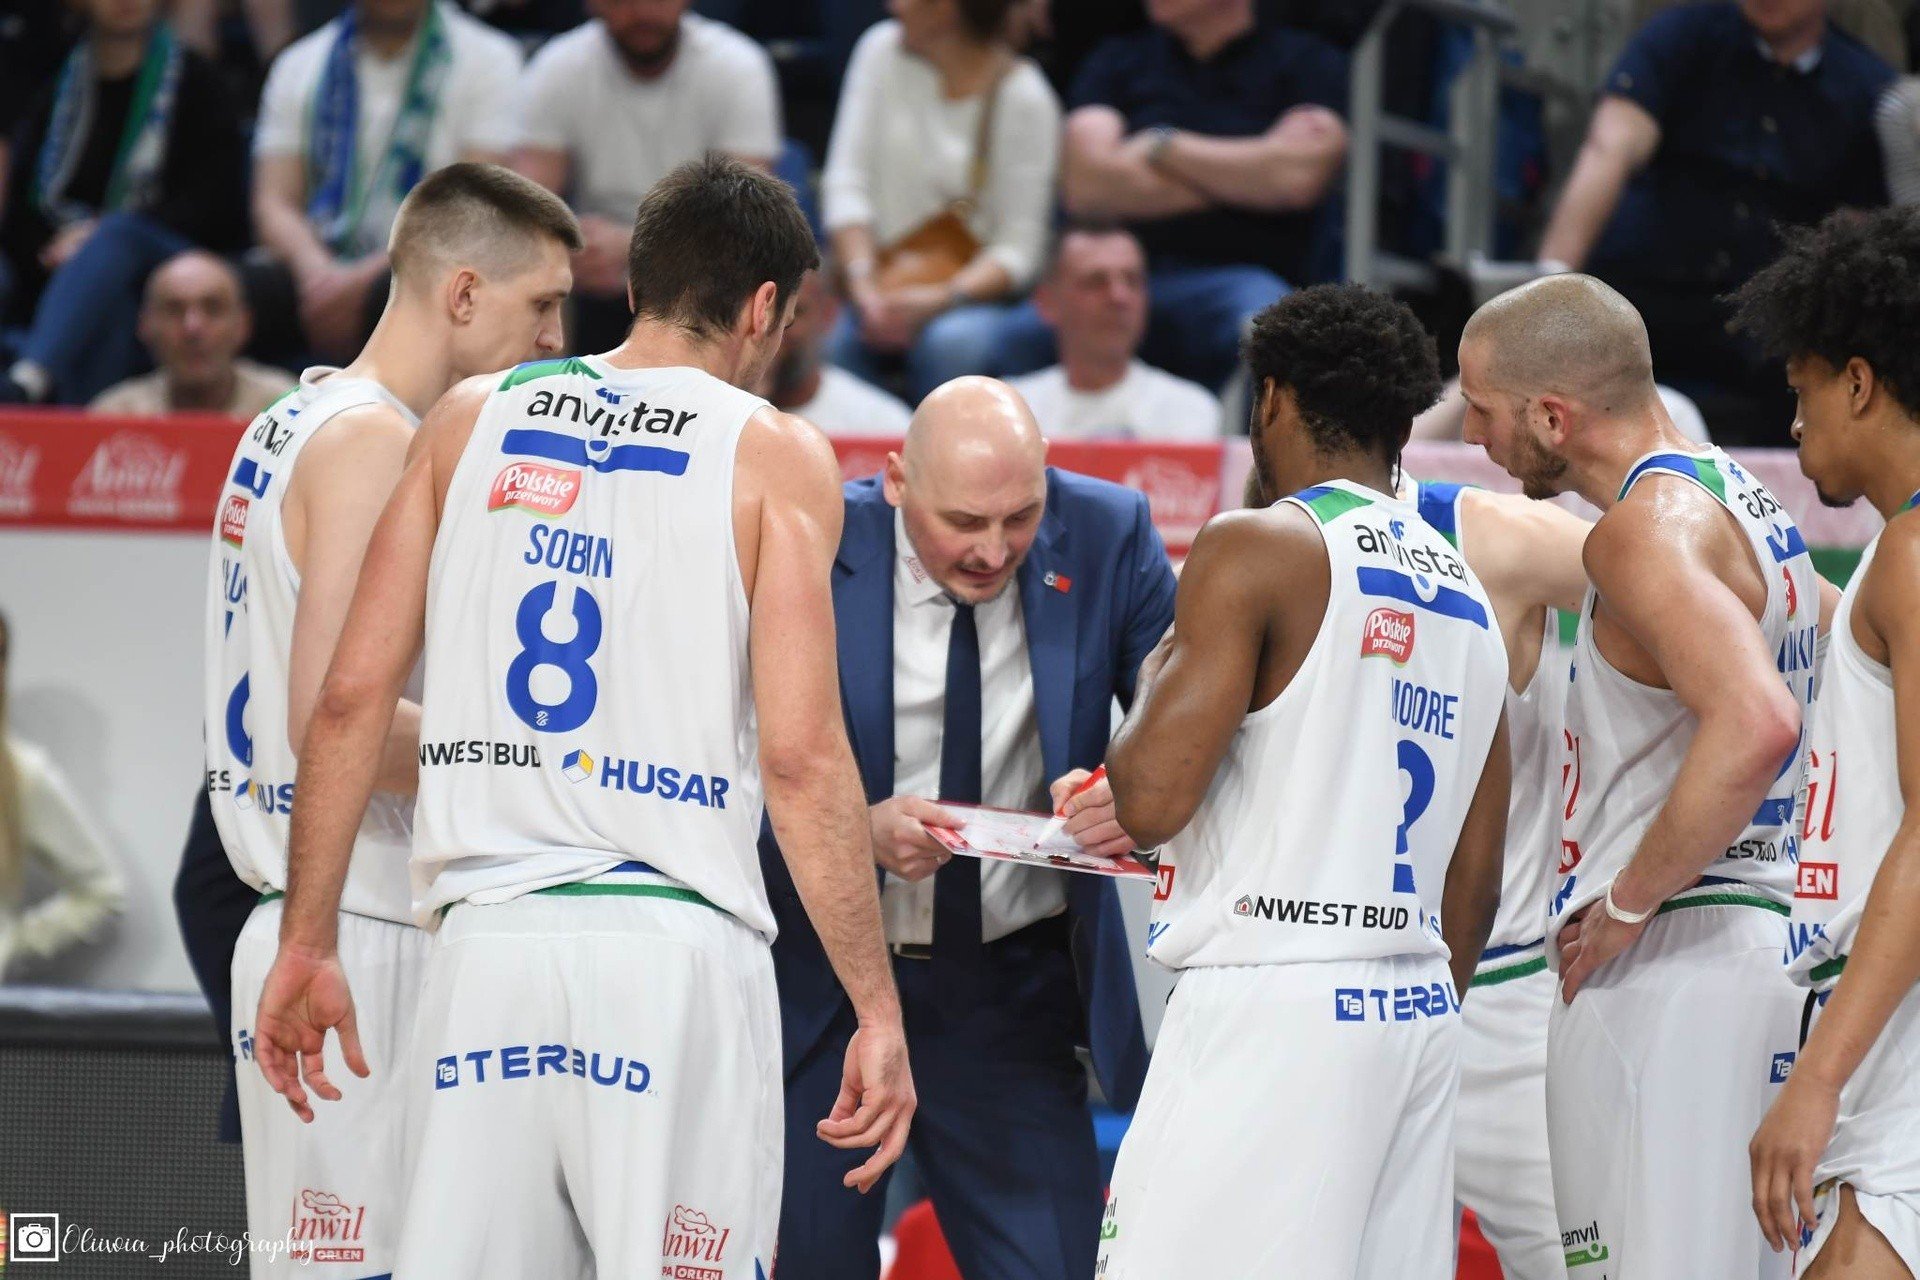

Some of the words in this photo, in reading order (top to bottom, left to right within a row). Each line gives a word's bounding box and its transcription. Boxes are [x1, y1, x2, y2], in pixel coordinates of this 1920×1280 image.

[502, 467, 574, 498] Polskie
[524, 523, 614, 579] SOBIN
[506, 580, 602, 733] 8
[600, 755, 730, 810] HUSAR
[1362, 905, 1409, 931] BUD
